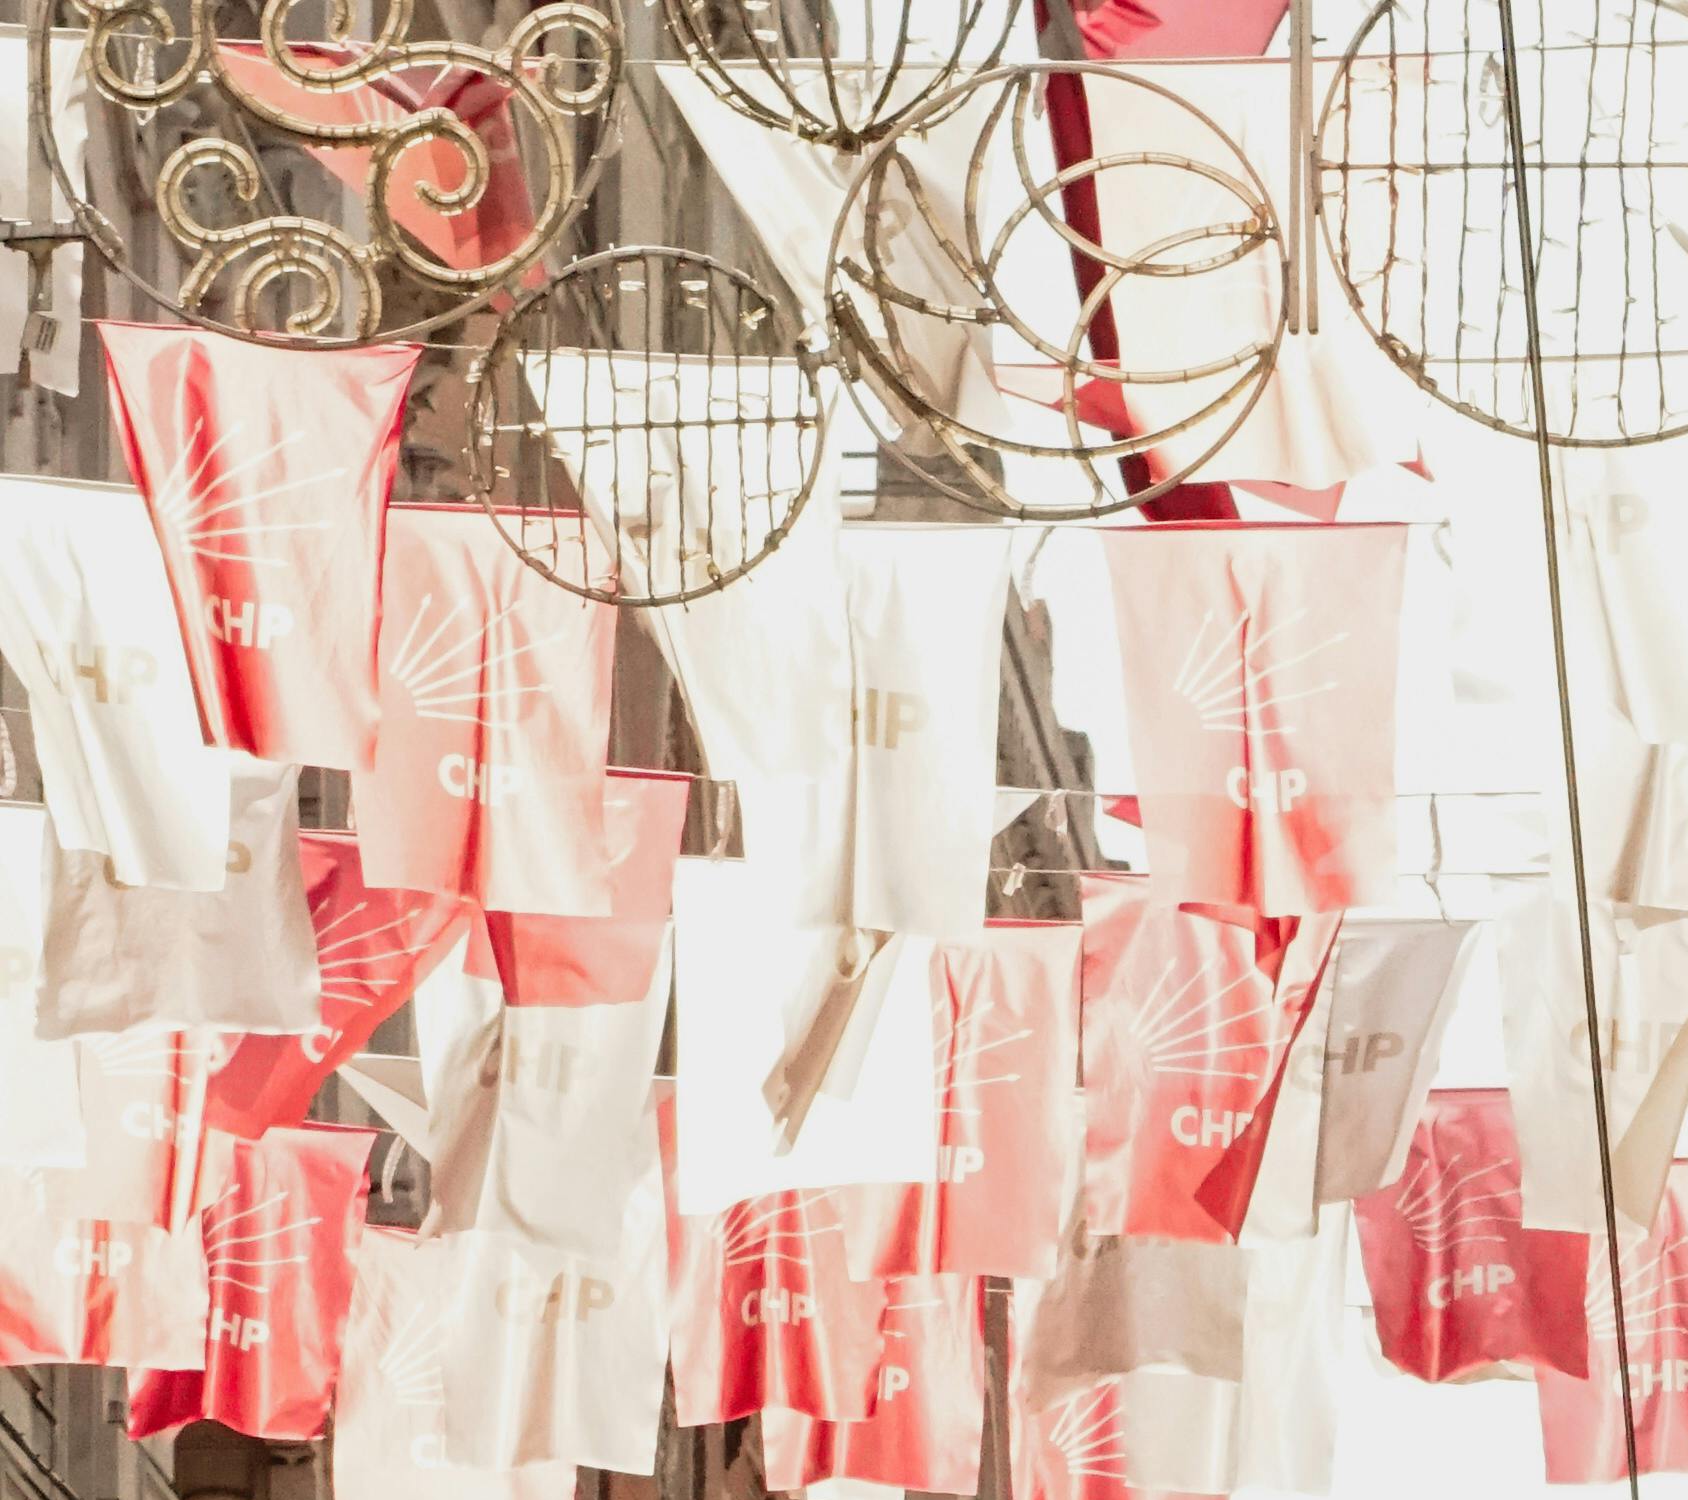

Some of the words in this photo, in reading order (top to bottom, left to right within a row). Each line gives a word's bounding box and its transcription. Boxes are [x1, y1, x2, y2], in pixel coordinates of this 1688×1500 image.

[206, 598, 294, 650] CHP
[437, 755, 523, 806] CHP
[1226, 766, 1307, 814] CHP
[1293, 1031, 1406, 1093] CHP
[56, 1236, 132, 1279] CHP
[741, 1288, 817, 1327] CHP
[1427, 1264, 1515, 1310] CHP
[209, 1306, 270, 1352] HP
